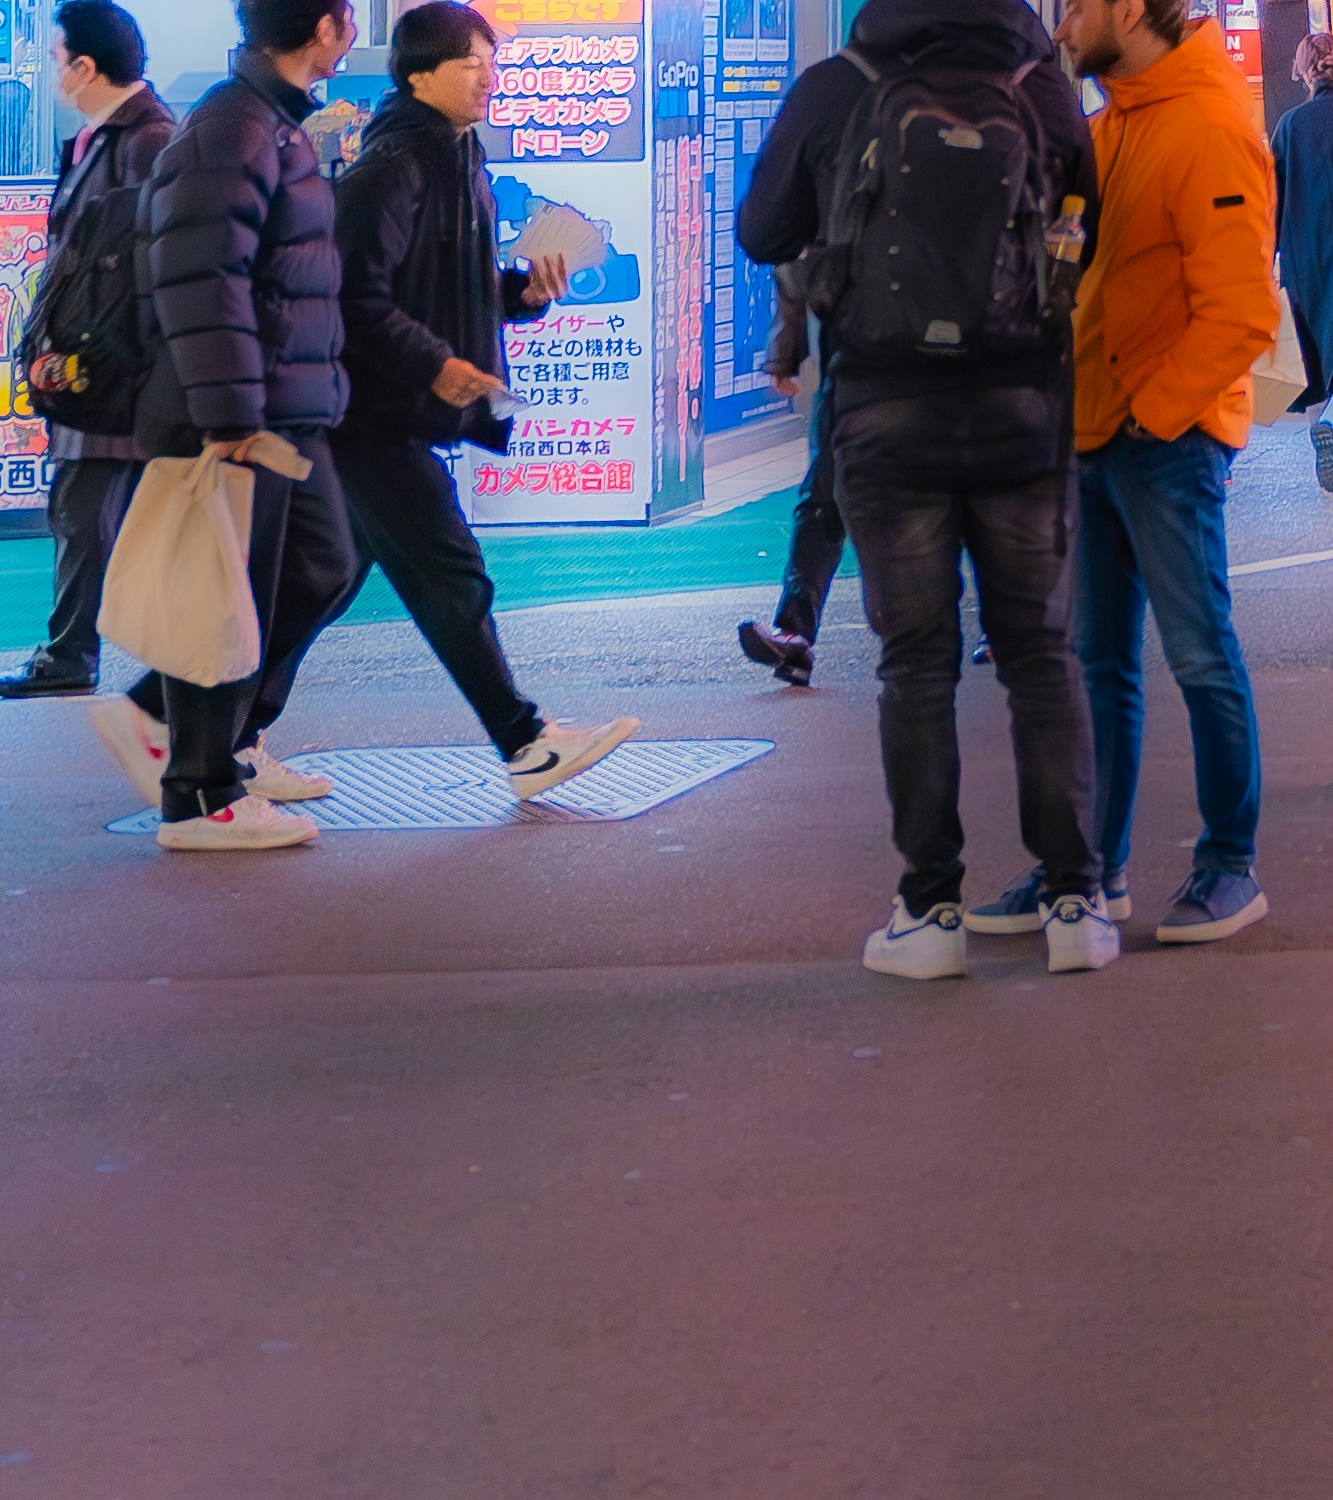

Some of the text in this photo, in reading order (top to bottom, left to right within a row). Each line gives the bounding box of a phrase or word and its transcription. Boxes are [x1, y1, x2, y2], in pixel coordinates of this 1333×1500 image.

[494, 35, 638, 65] ェアラブルカメラ
[658, 59, 699, 88] GoPro
[512, 128, 610, 160] ドローン
[474, 461, 636, 495] カメラ総合館
